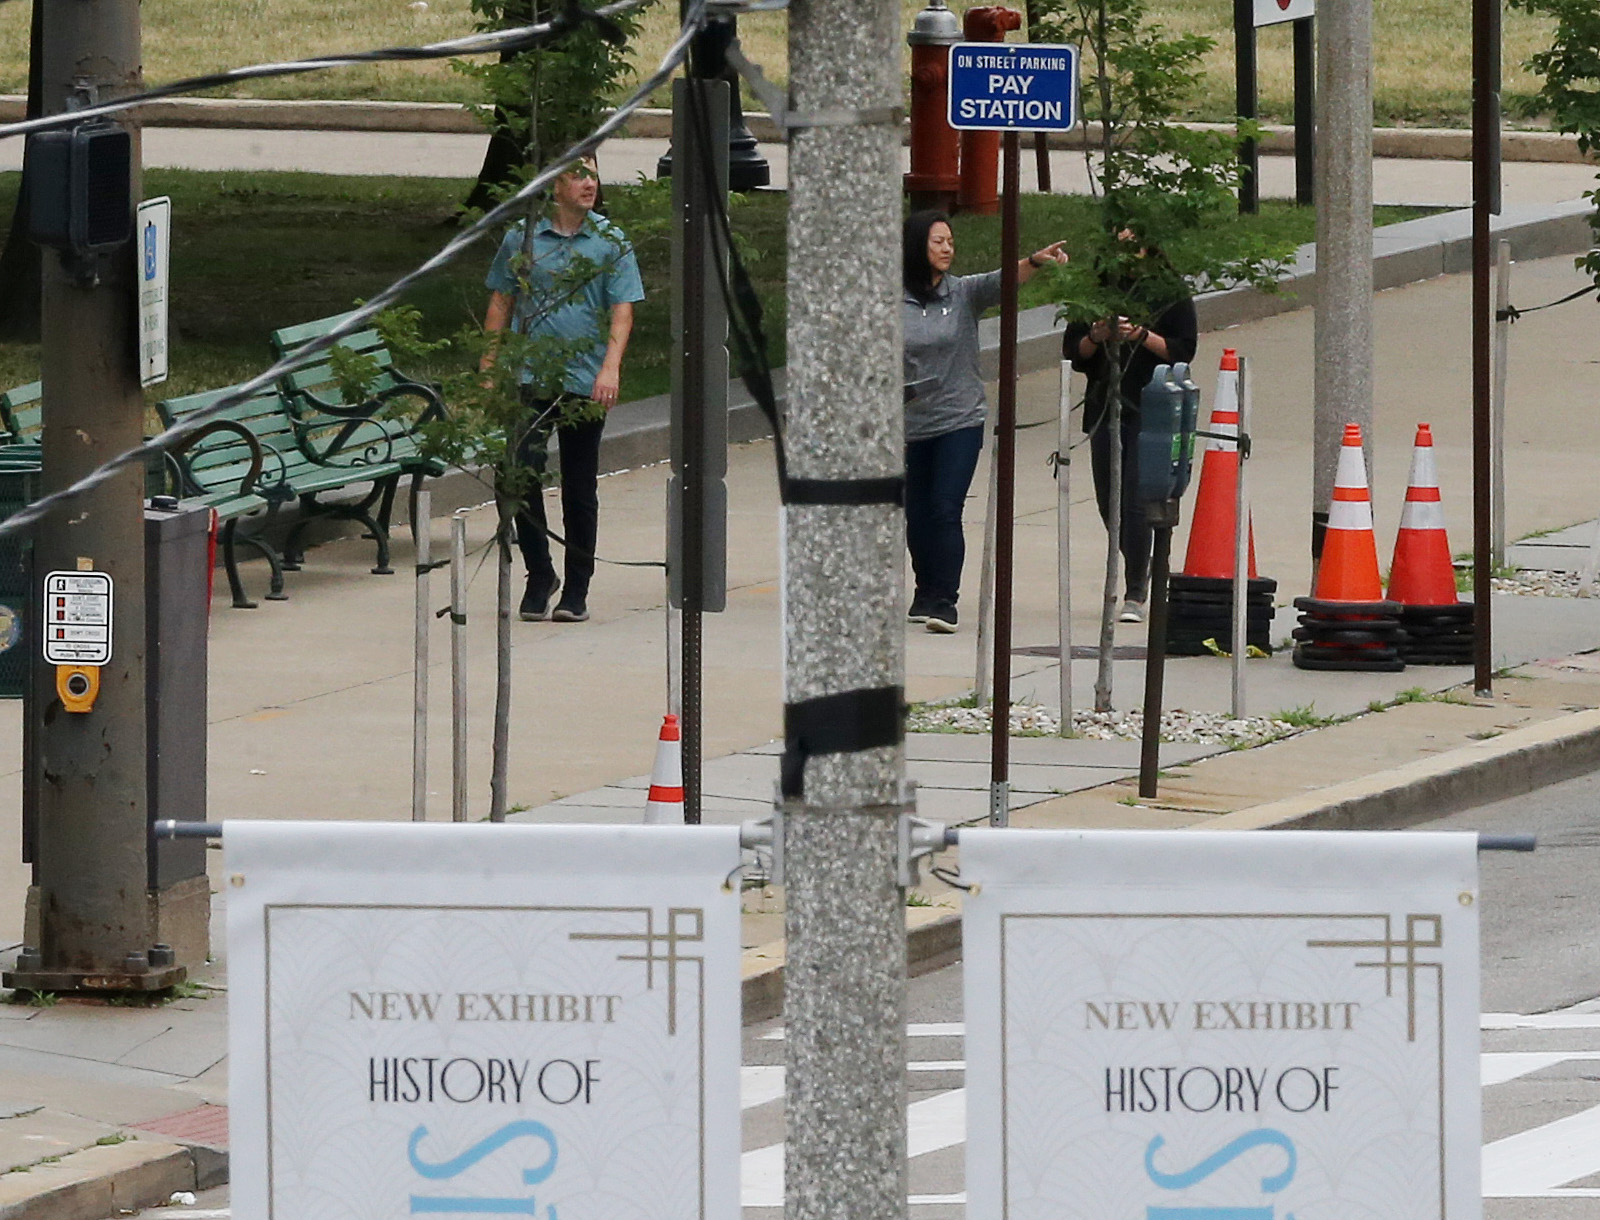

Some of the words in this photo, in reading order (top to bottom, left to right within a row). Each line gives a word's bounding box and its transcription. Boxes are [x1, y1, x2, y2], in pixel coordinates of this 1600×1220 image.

[958, 55, 972, 68] ON
[976, 55, 1017, 69] STREET
[1020, 56, 1066, 71] PARKING
[988, 74, 1034, 95] PAY
[960, 98, 1061, 120] STATION
[350, 993, 441, 1020] NEW
[457, 994, 621, 1022] EXHIBIT
[1086, 1002, 1178, 1029] NEW
[1195, 1002, 1360, 1029] EXHIBIT
[370, 1057, 529, 1104] HISTORY
[537, 1059, 600, 1105] OF
[1105, 1067, 1267, 1112] HISTORY
[1276, 1067, 1339, 1112] OF
